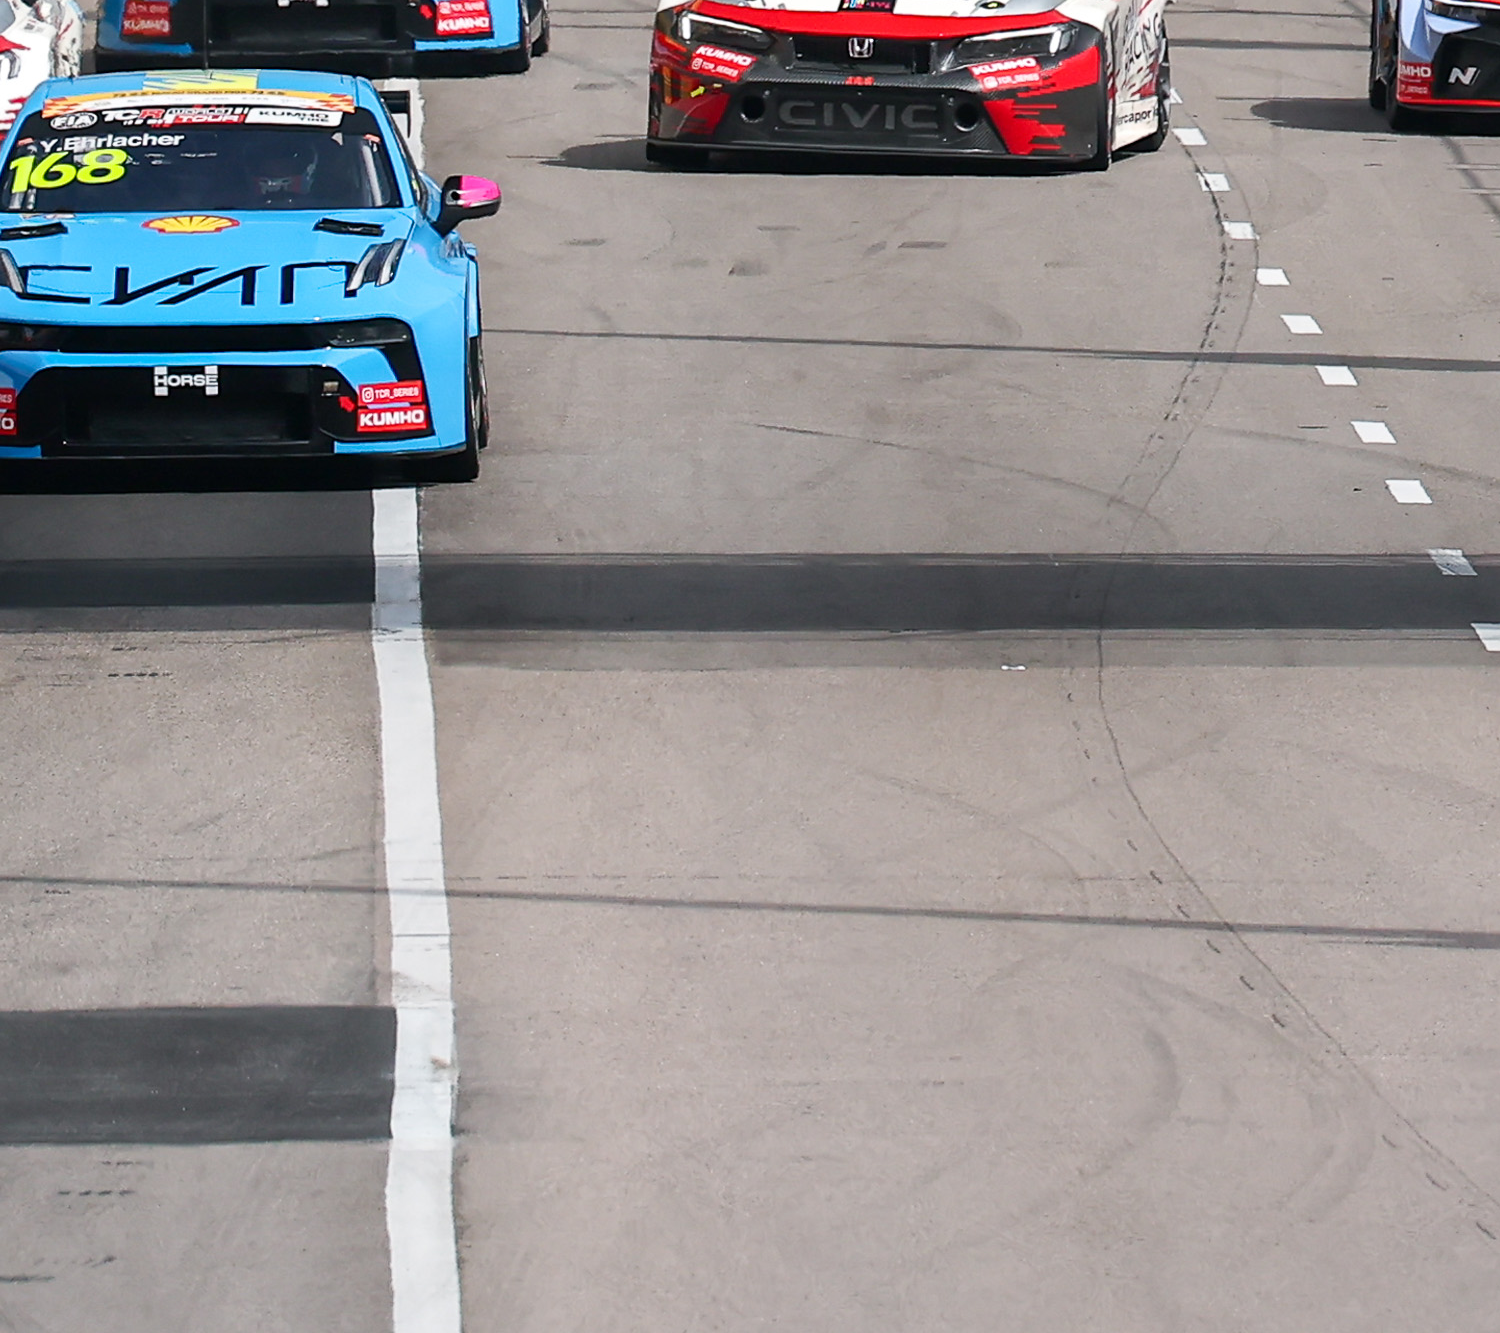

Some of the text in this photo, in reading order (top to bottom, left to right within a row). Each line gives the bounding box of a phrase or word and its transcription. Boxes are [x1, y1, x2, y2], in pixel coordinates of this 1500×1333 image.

[697, 45, 752, 66] KUMHO
[972, 57, 1037, 76] KUMHO
[53, 114, 95, 129] FIA
[103, 108, 166, 122] TCR
[176, 115, 244, 124] TOUR
[258, 110, 330, 119] KUMHO
[779, 101, 938, 129] CIVIC
[40, 133, 184, 153] Y.Ehrlacher
[9, 148, 128, 194] 168
[359, 408, 425, 427] KUMHO
